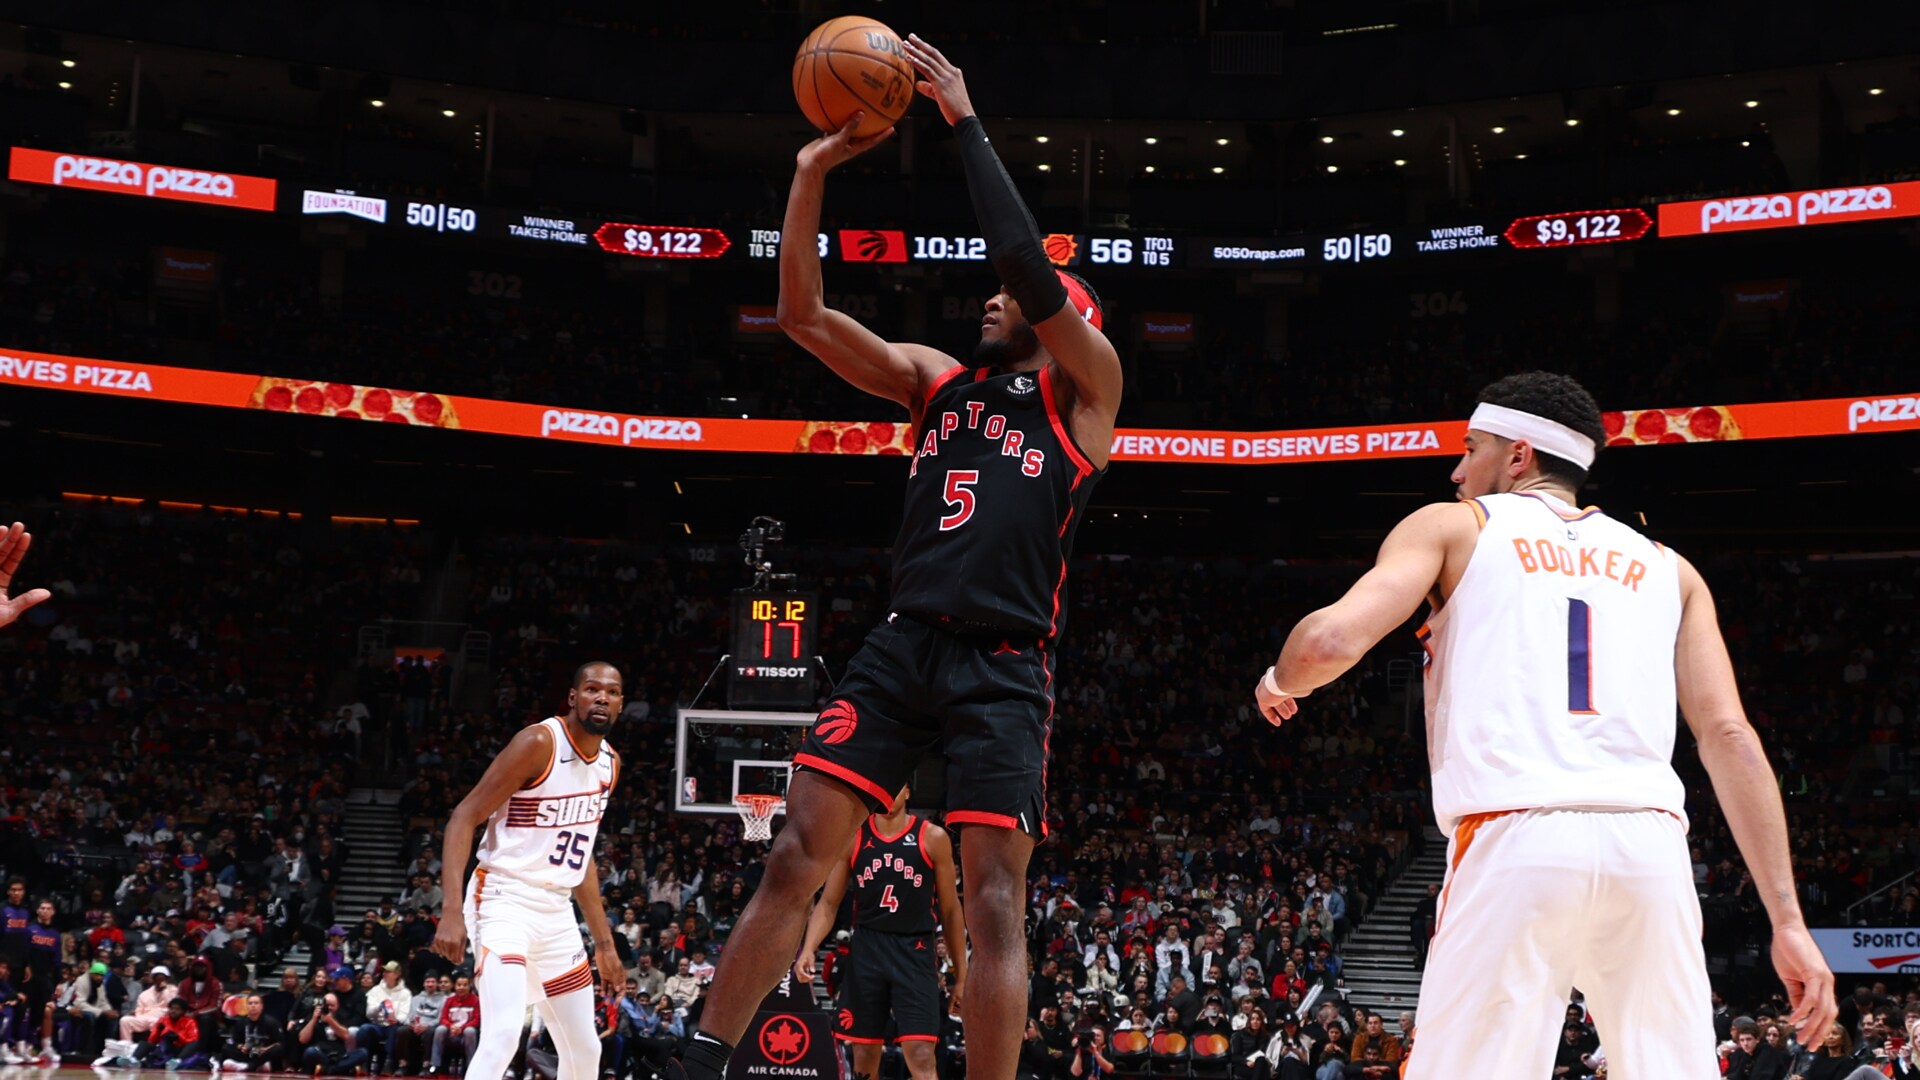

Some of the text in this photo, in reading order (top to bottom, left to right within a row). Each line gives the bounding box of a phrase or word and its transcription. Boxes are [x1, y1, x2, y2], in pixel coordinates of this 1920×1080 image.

[307, 194, 381, 217] FOUNDATION
[508, 224, 588, 244] TAKES HOME
[523, 215, 575, 231] WINNER
[1431, 225, 1484, 240] WINNER
[1536, 214, 1621, 244] $9,122
[623, 228, 702, 255] $9,122
[748, 243, 777, 258] TO 5
[913, 236, 987, 260] 10:12
[1090, 238, 1133, 264] 56
[1213, 247, 1305, 261] 5050raps.com
[1416, 235, 1499, 252] TAKES HOME
[1141, 251, 1170, 266] TO 5
[467, 269, 523, 299] 302
[1410, 290, 1468, 318] 304
[0, 355, 152, 392] RVES PIZZA
[1848, 397, 1920, 432] pizz
[909, 400, 1045, 479] RAPTORS
[1110, 429, 1440, 458] VERYONE DESERVES PIZZA
[939, 469, 980, 531] 5
[1512, 537, 1647, 592] BOOKER
[764, 621, 800, 659] 17
[1565, 597, 1600, 715] 1
[535, 793, 602, 828] SUNS
[548, 830, 590, 871] 35
[857, 853, 923, 888] RAPTORS
[880, 884, 899, 913] 4
[778, 969, 791, 997] JAC
[747, 1066, 818, 1077] AIR CANADA
